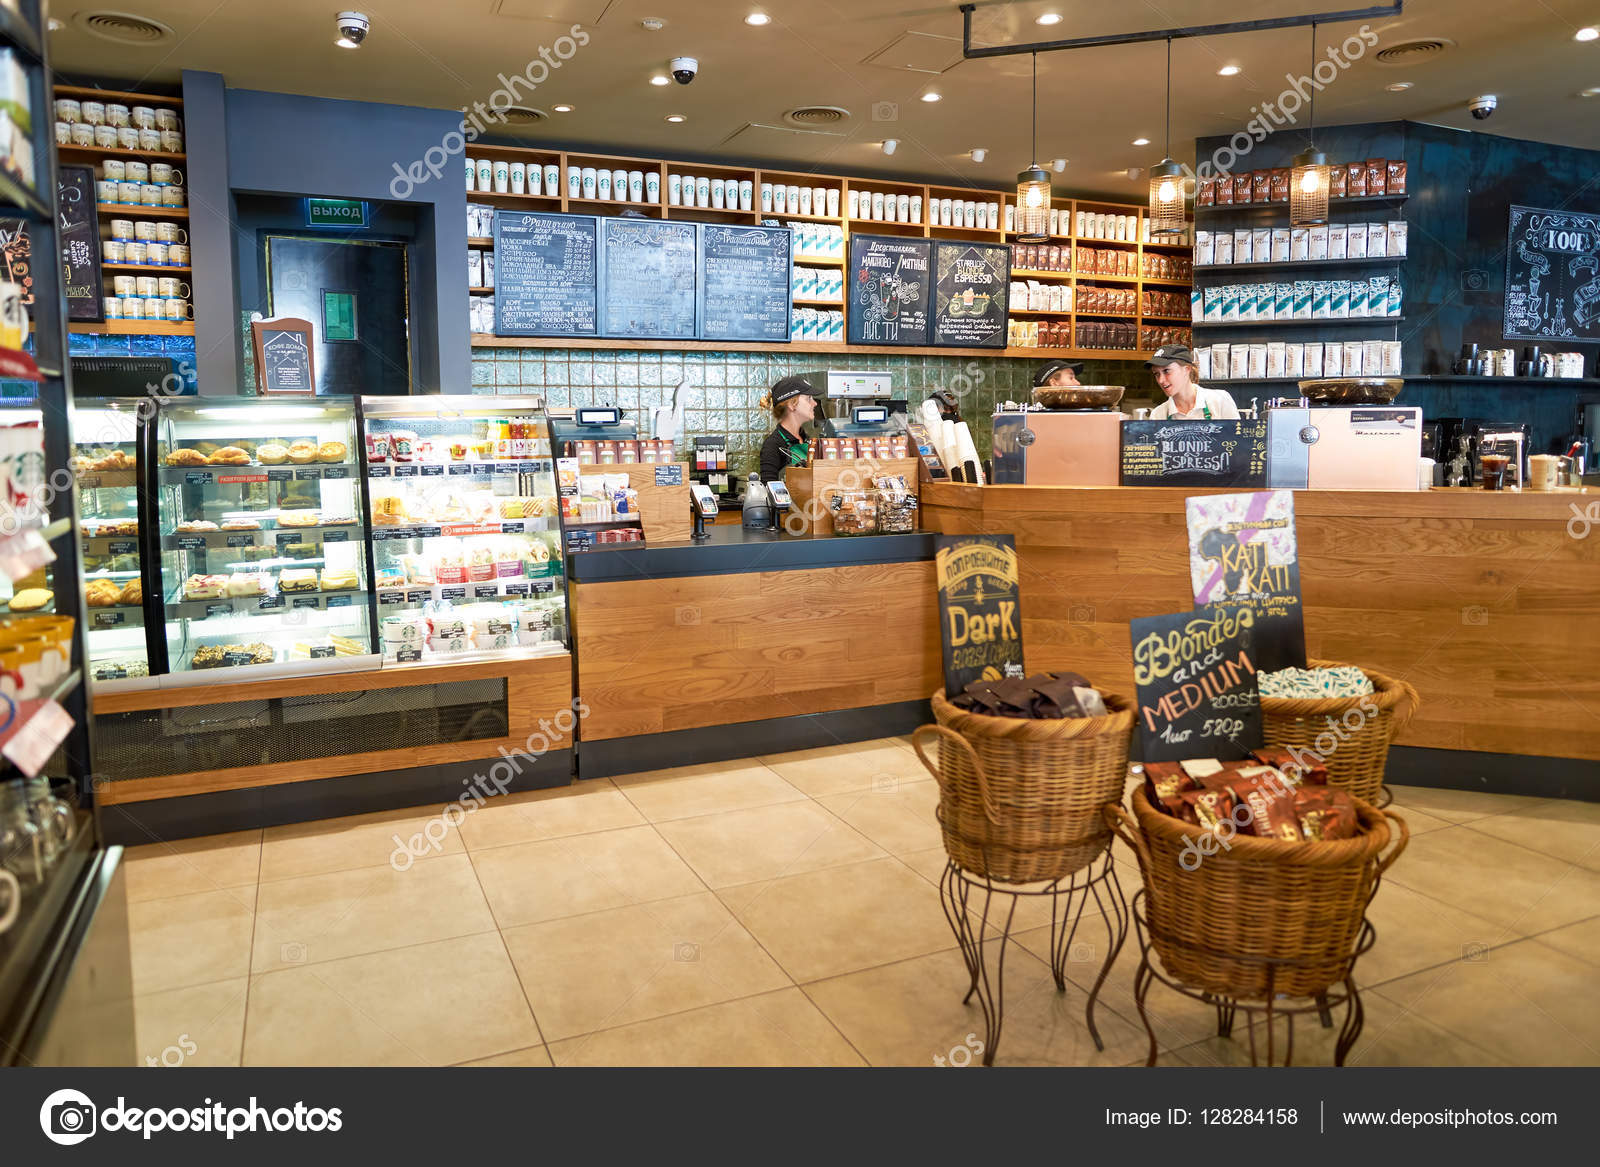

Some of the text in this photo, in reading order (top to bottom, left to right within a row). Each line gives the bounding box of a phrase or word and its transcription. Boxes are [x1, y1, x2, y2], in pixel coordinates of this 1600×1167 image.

[312, 206, 361, 219] ВЫХОД
[954, 274, 993, 284] ESPRESSO
[956, 267, 985, 275] BLONDE
[1162, 440, 1212, 453] BLONDE
[1221, 541, 1269, 573] KATI
[1247, 565, 1290, 593] KATI
[1134, 608, 1255, 686] Blonde
[1172, 647, 1225, 684] and
[1142, 650, 1256, 732] MEDIUM
